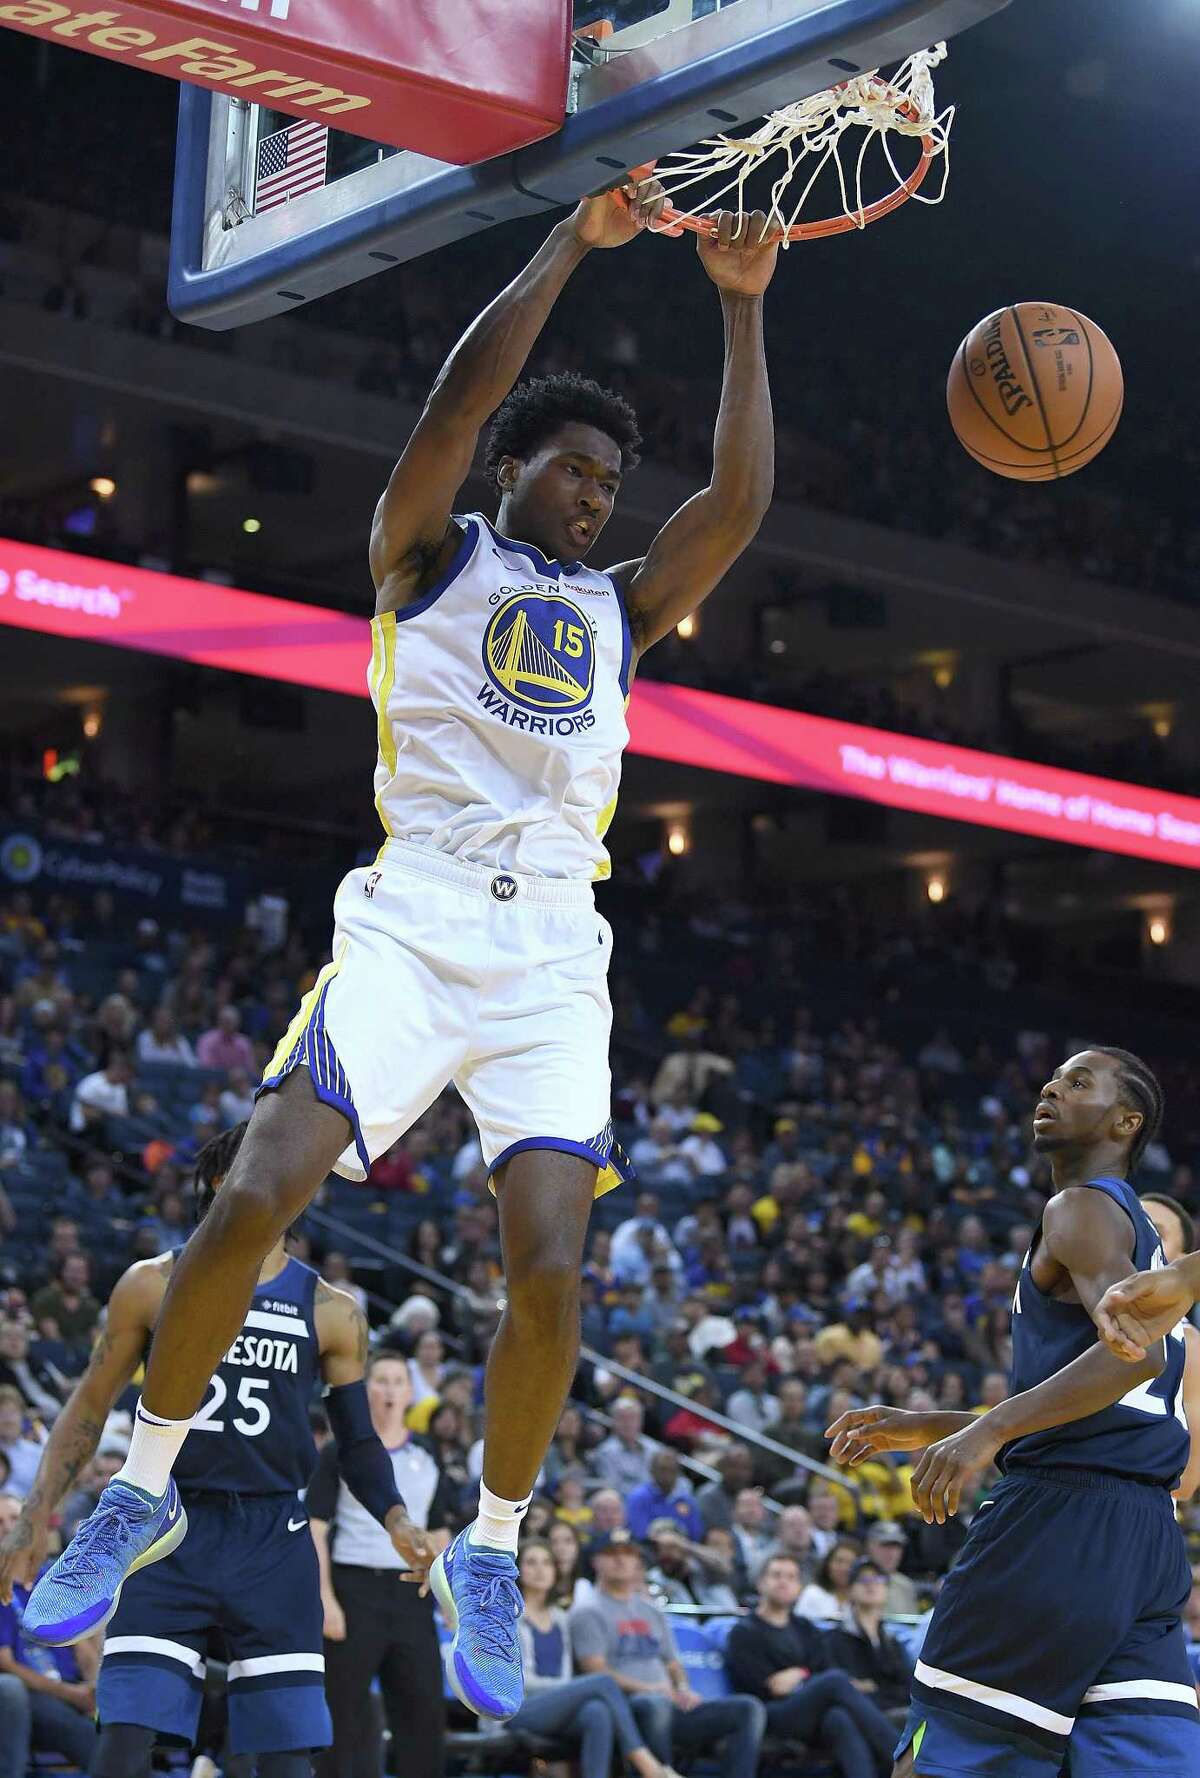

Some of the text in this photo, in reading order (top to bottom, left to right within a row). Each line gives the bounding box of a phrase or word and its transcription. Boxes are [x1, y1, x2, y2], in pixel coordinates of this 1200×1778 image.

[136, 37, 372, 115] Farm
[15, 569, 121, 619] Search
[488, 584, 560, 606] GOLDEN
[553, 619, 584, 658] 15
[476, 682, 596, 736] WARRIORS
[839, 744, 886, 780] The
[995, 778, 1062, 817] Home
[1062, 795, 1091, 822] of
[1091, 798, 1156, 837] Home
[272, 1301, 298, 1316] fitbit
[222, 1335, 298, 1374] ESOTA
[189, 1374, 271, 1437] 25
